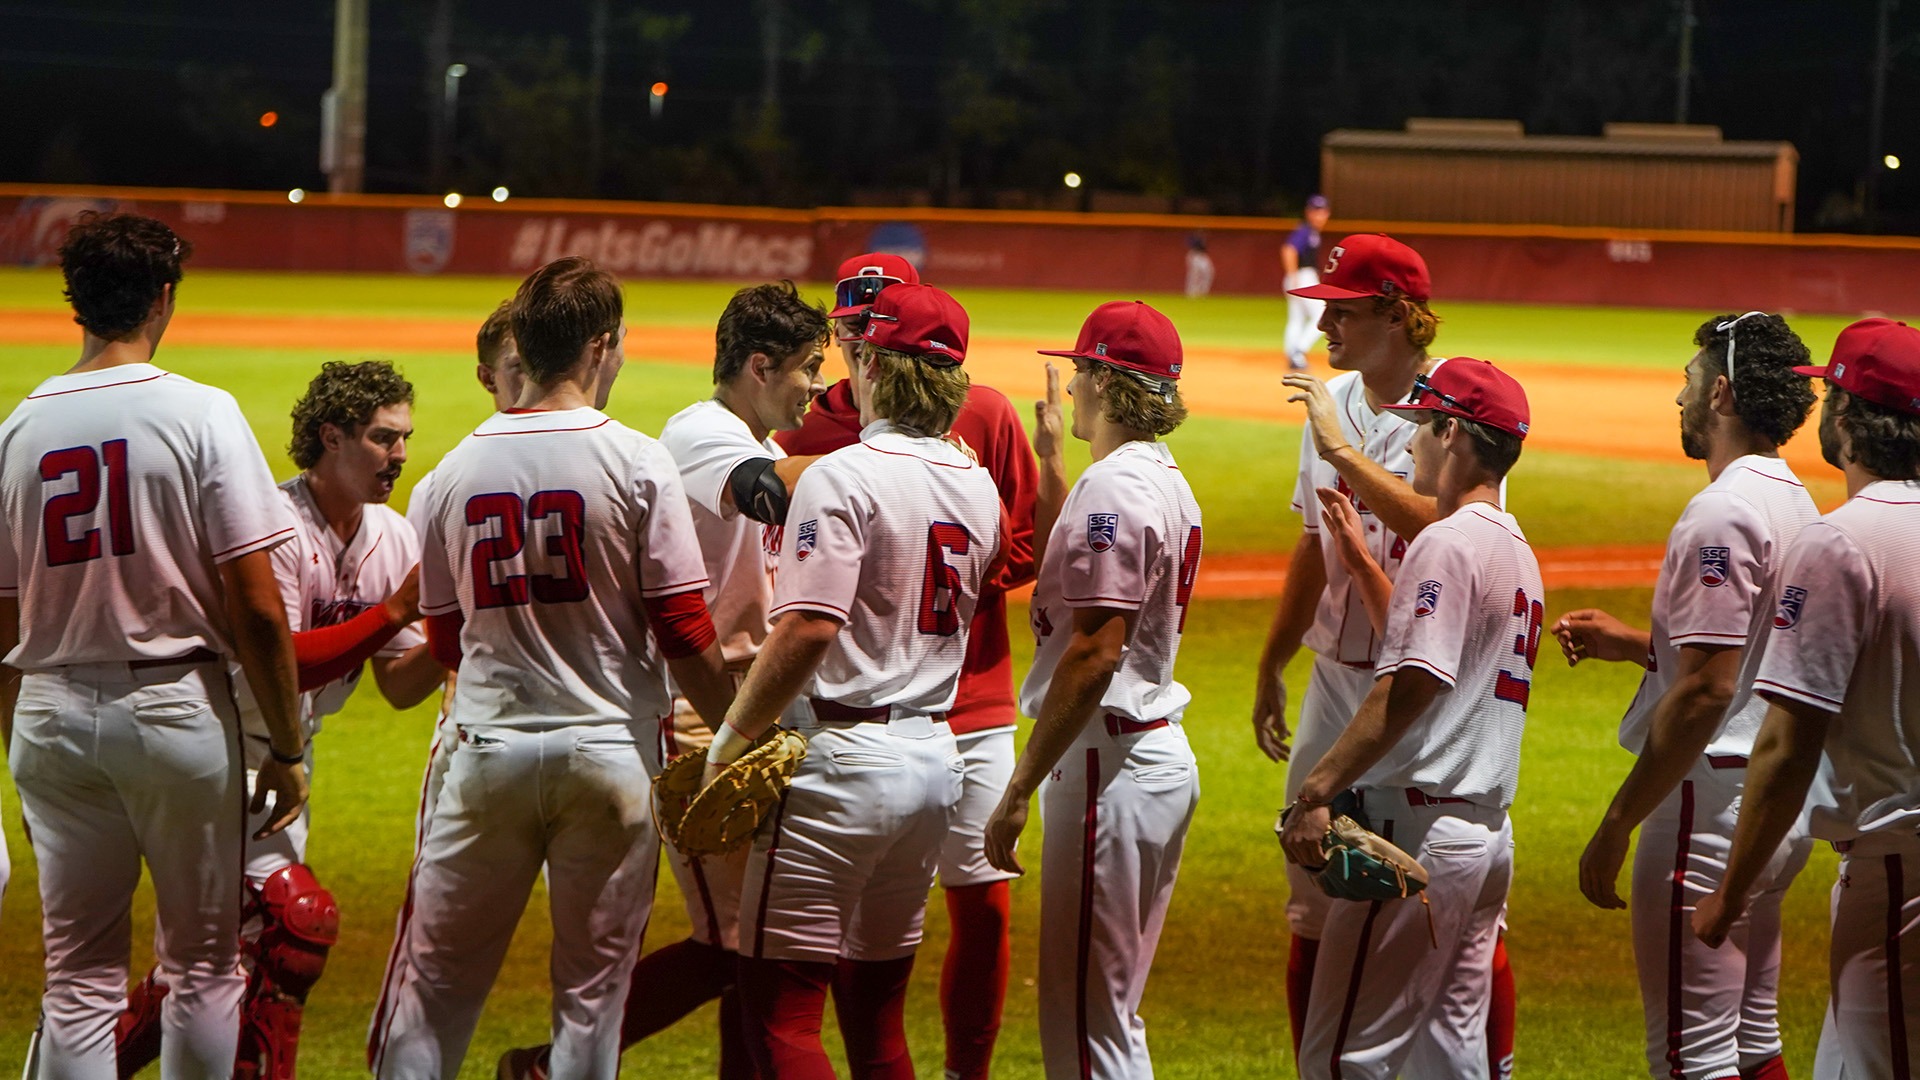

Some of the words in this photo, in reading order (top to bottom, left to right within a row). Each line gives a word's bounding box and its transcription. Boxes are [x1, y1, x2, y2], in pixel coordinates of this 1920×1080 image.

[1323, 246, 1346, 274] S
[39, 438, 135, 568] 21
[799, 521, 818, 536] SSC
[1090, 516, 1115, 526] SSC
[465, 490, 591, 610] 23
[917, 520, 970, 637] 6
[1175, 525, 1202, 635] 4
[1702, 549, 1728, 559] SSC
